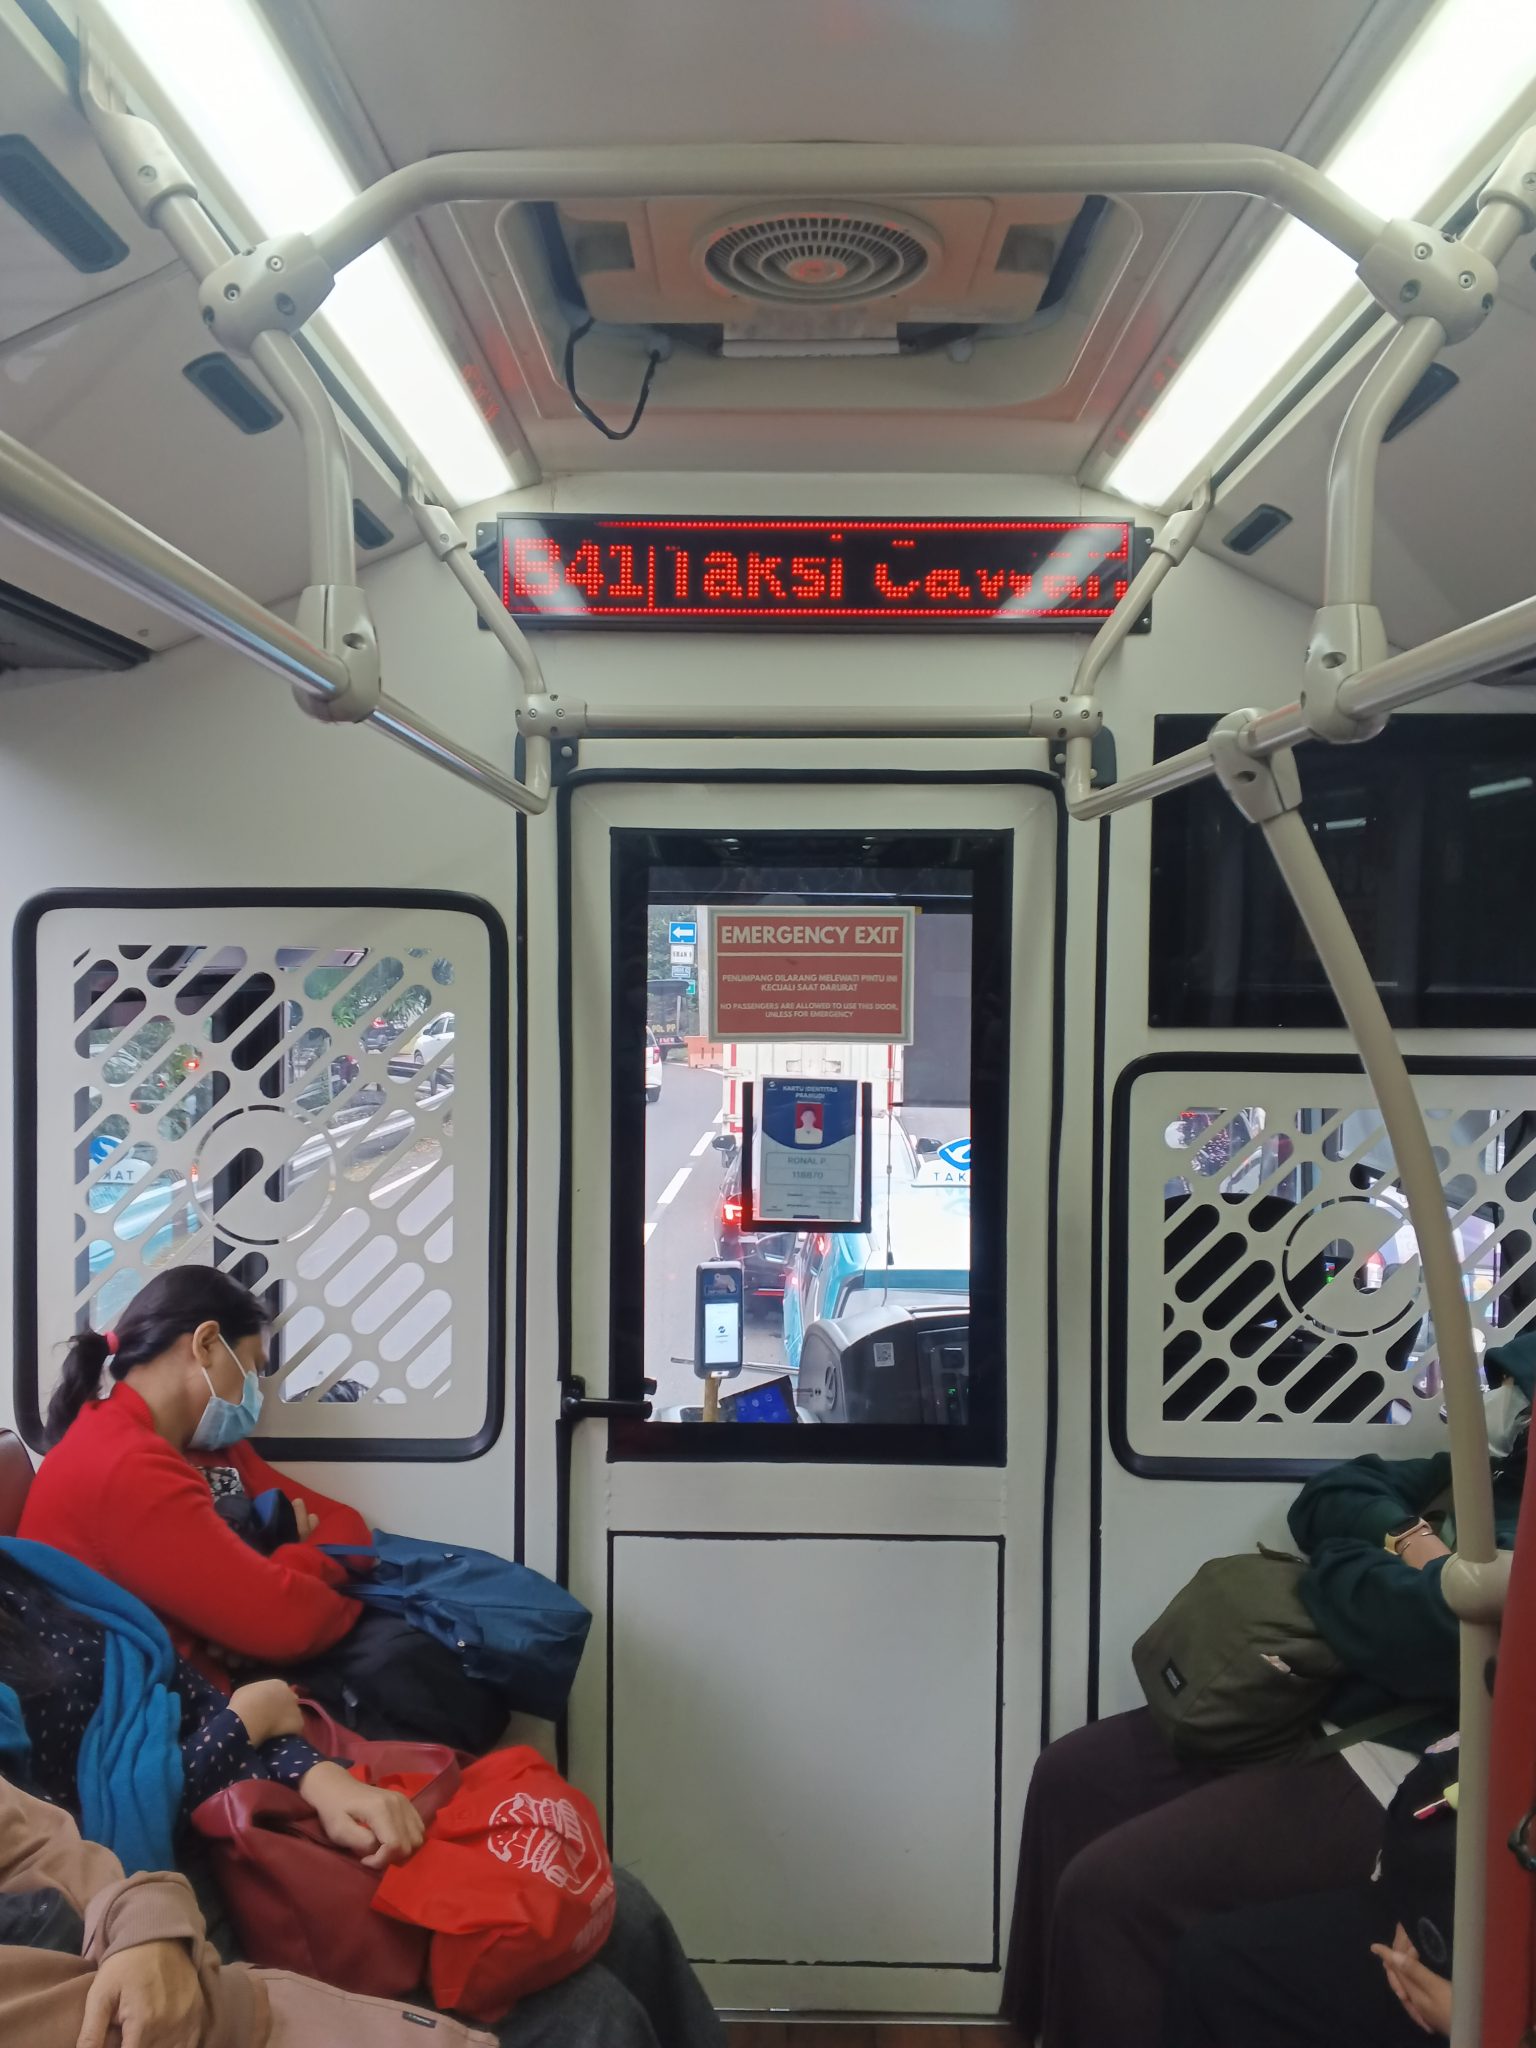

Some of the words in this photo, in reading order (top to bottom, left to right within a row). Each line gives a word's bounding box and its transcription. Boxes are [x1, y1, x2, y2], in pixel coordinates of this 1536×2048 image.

[721, 925, 850, 945] EMERGENCY
[855, 926, 899, 945] EXIT
[722, 974, 773, 982] PENUMPANG
[775, 974, 817, 982] DILARANG
[818, 974, 860, 982] MELEWATI
[760, 983, 796, 991] KECUALI
[797, 983, 819, 991] SAAT
[820, 983, 858, 992] DARURAT
[720, 1002, 732, 1010] NO
[733, 1002, 779, 1010] PASSENGERS
[780, 1002, 795, 1010] ARE
[796, 1002, 831, 1010] ALLOWED
[832, 1002, 842, 1010] TO
[843, 1002, 857, 1010] USE
[858, 1002, 873, 1010] THIS
[765, 1010, 793, 1018] UNLESS
[794, 1010, 809, 1018] FOR
[810, 1010, 854, 1018] EMERGENCY
